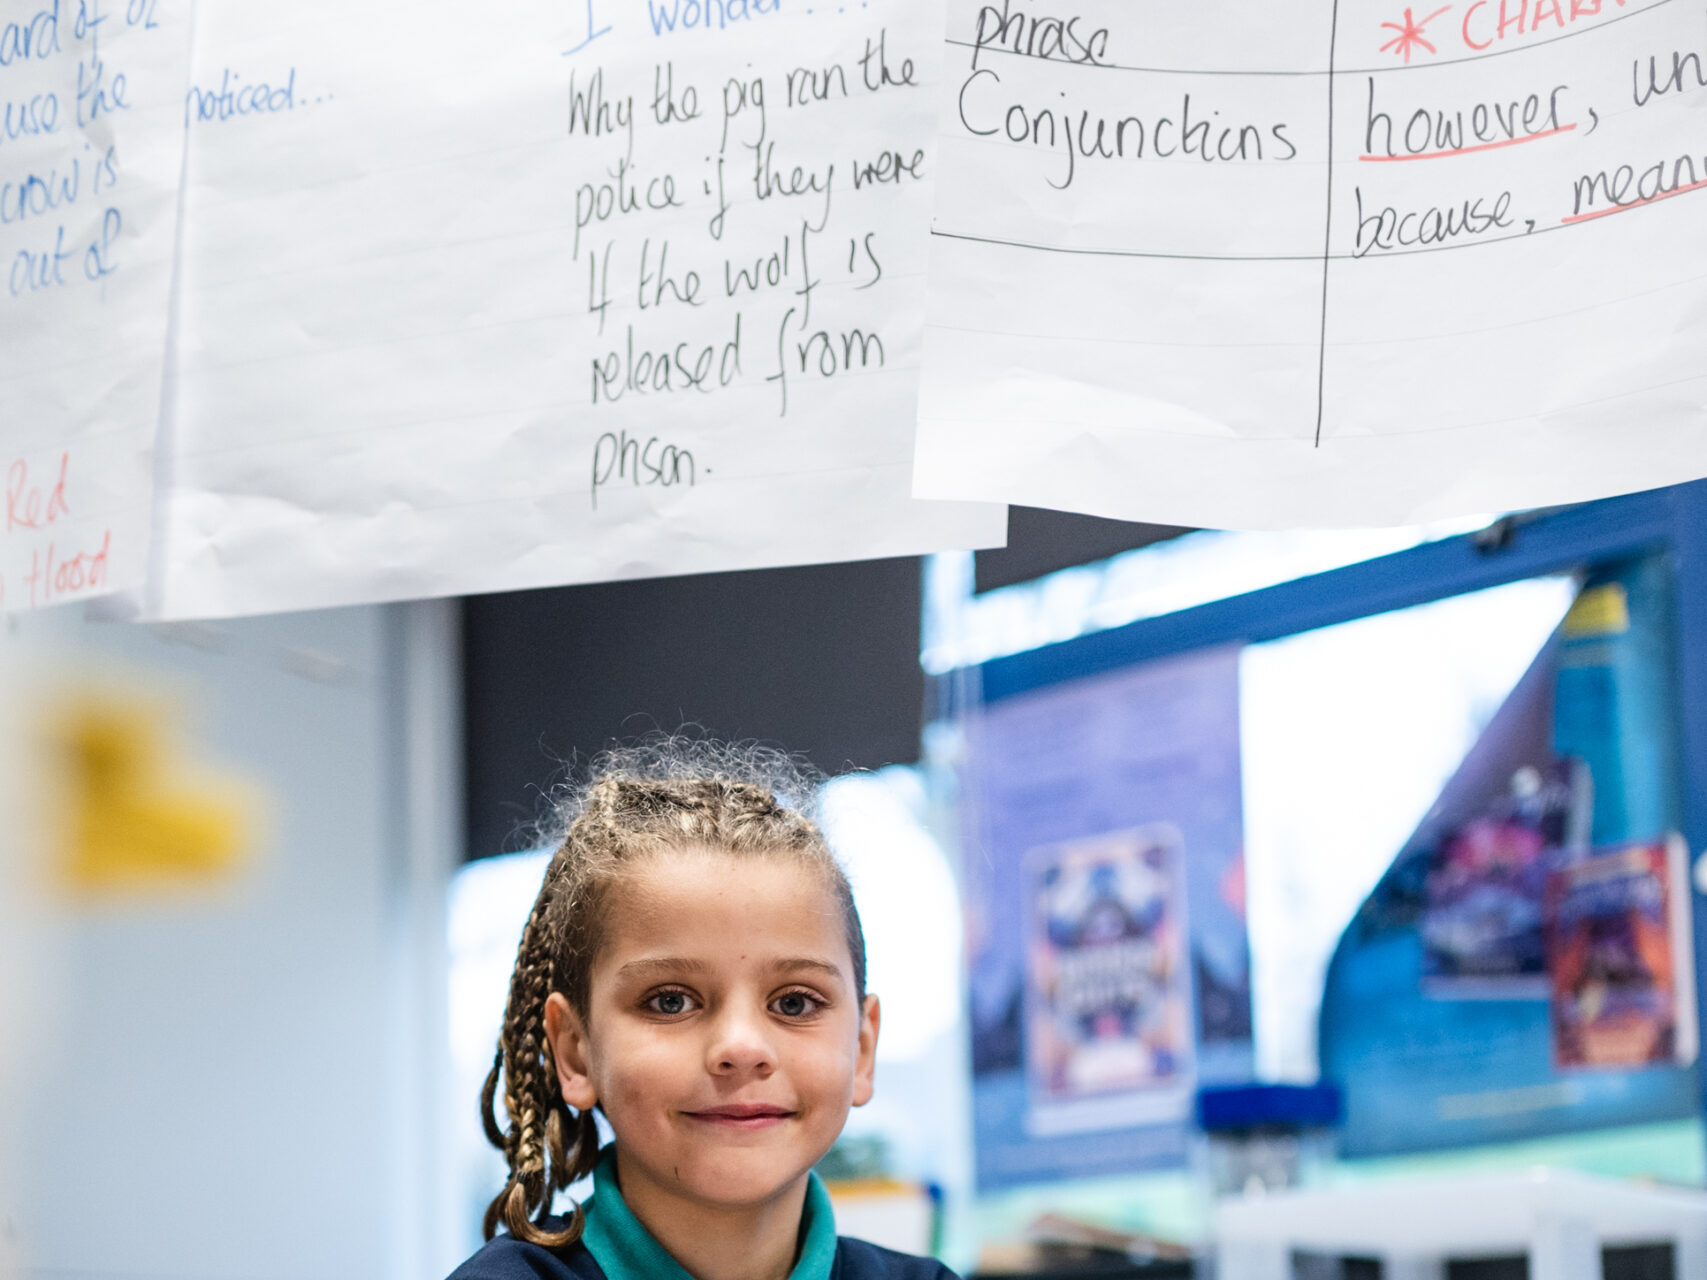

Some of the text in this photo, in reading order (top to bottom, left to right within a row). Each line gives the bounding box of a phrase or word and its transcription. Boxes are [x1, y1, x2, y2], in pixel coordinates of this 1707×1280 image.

[971, 0, 1117, 70] phrase
[77, 61, 131, 128] the
[569, 67, 633, 176] Why
[650, 61, 703, 124] the
[720, 63, 766, 153] pig
[857, 27, 919, 91] the
[959, 69, 1297, 190] Conjunctions
[85, 144, 117, 195] is
[573, 141, 924, 261] police if they were
[9, 206, 122, 300] out of
[1352, 186, 1536, 259] because,
[588, 220, 882, 336] If the wolf is
[592, 307, 886, 417] released from
[6, 449, 70, 532] Red
